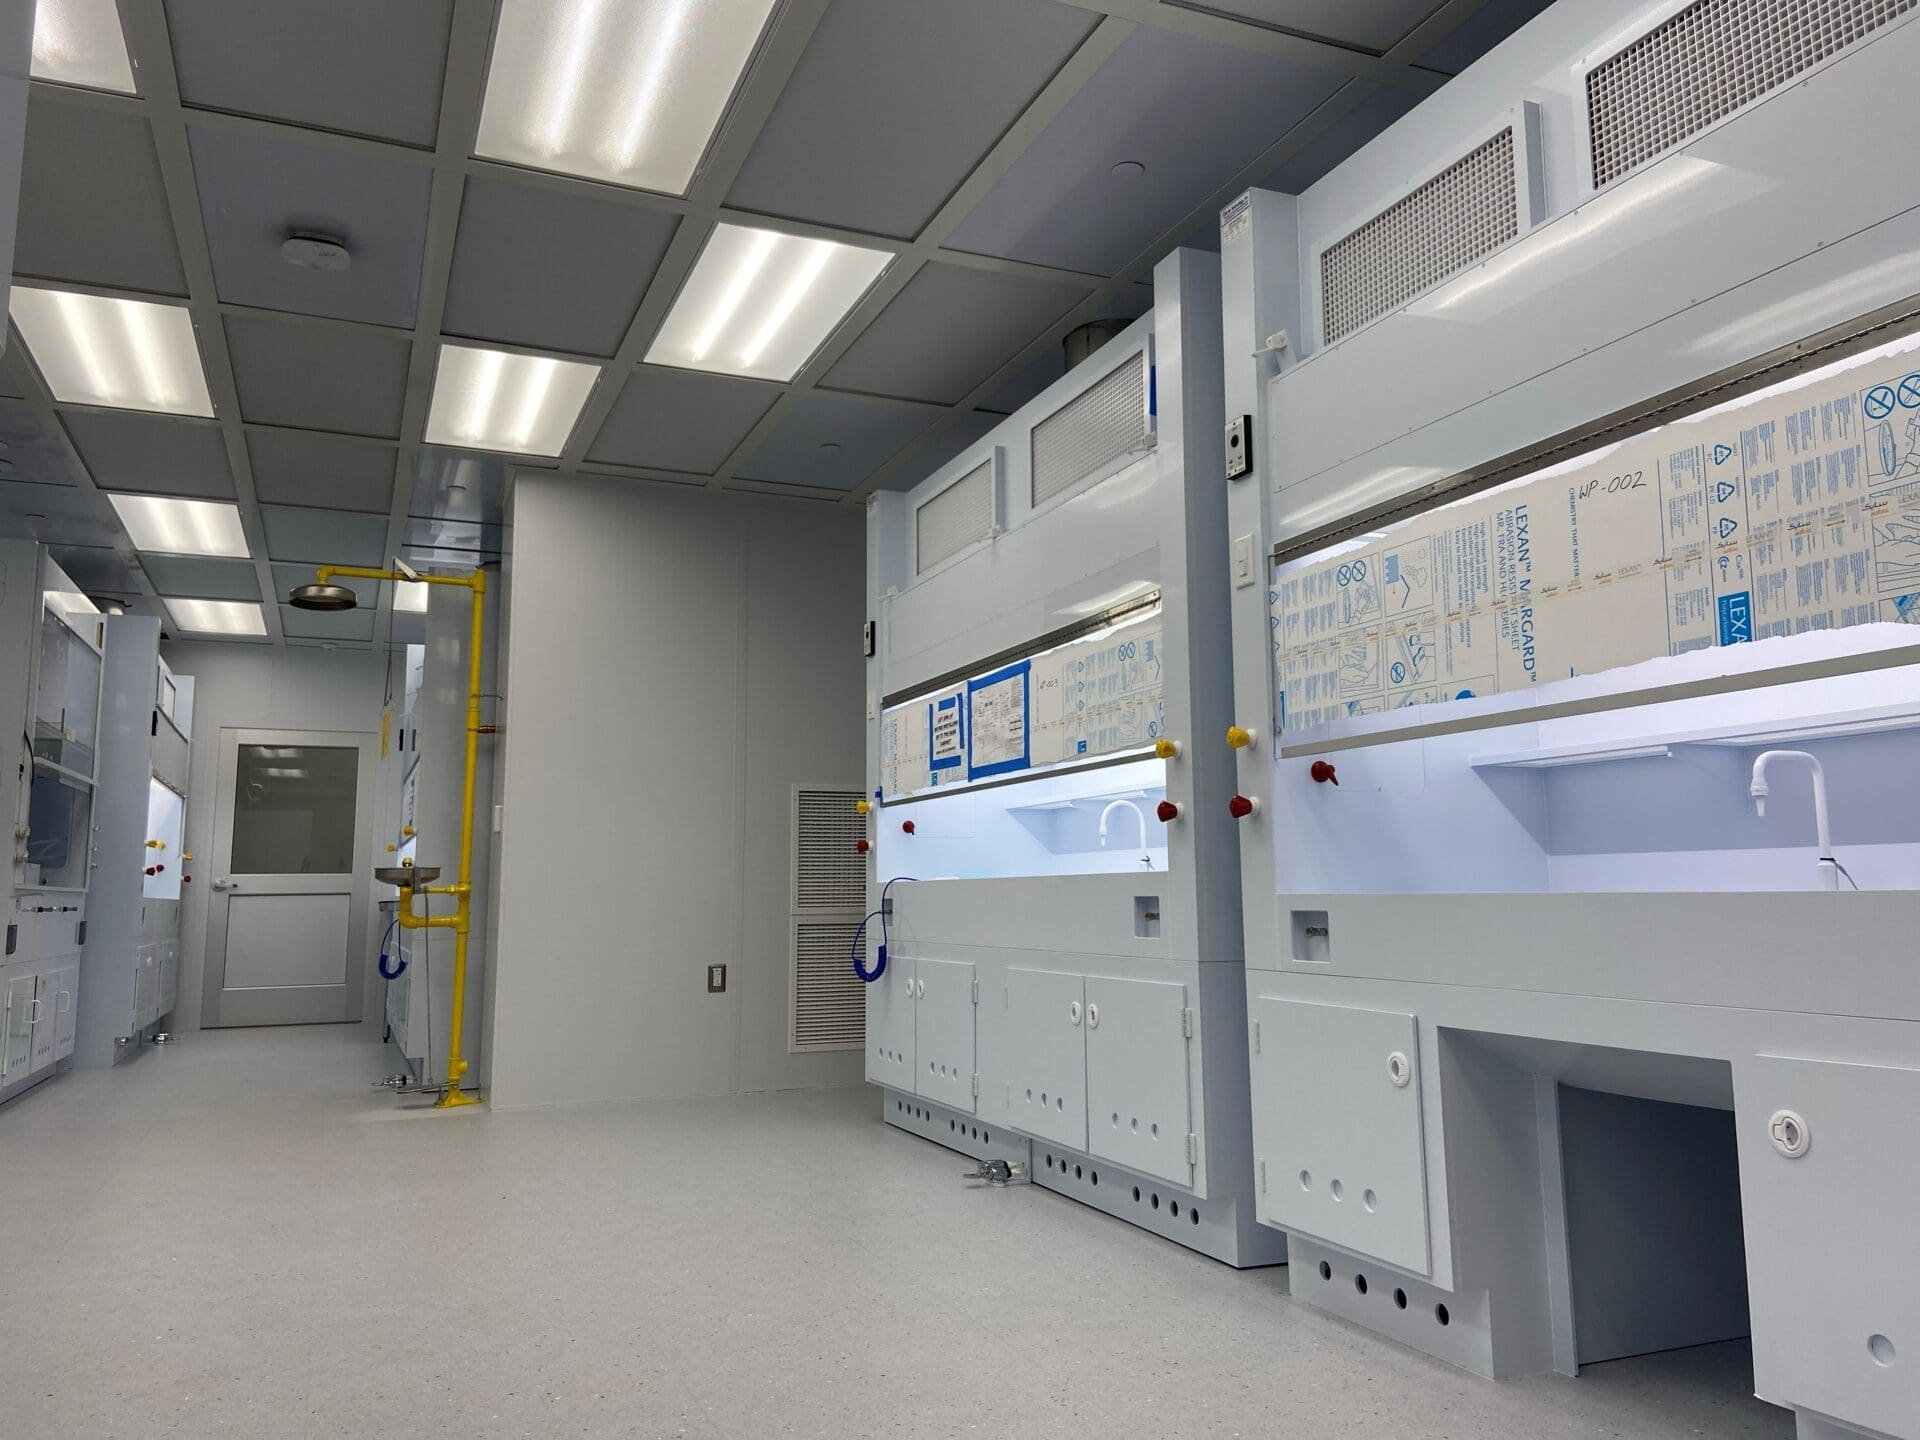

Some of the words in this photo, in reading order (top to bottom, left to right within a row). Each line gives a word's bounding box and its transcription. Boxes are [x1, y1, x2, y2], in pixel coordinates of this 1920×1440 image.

[1579, 471, 1647, 499] WP-002
[1569, 487, 1577, 526] CHEMISTRY
[1505, 509, 1517, 561] ABRASION
[1498, 555, 1508, 579] AND
[1500, 609, 1510, 639] ERIES
[1510, 619, 1520, 652] SHEET
[1520, 578, 1537, 683] MRGARD™
